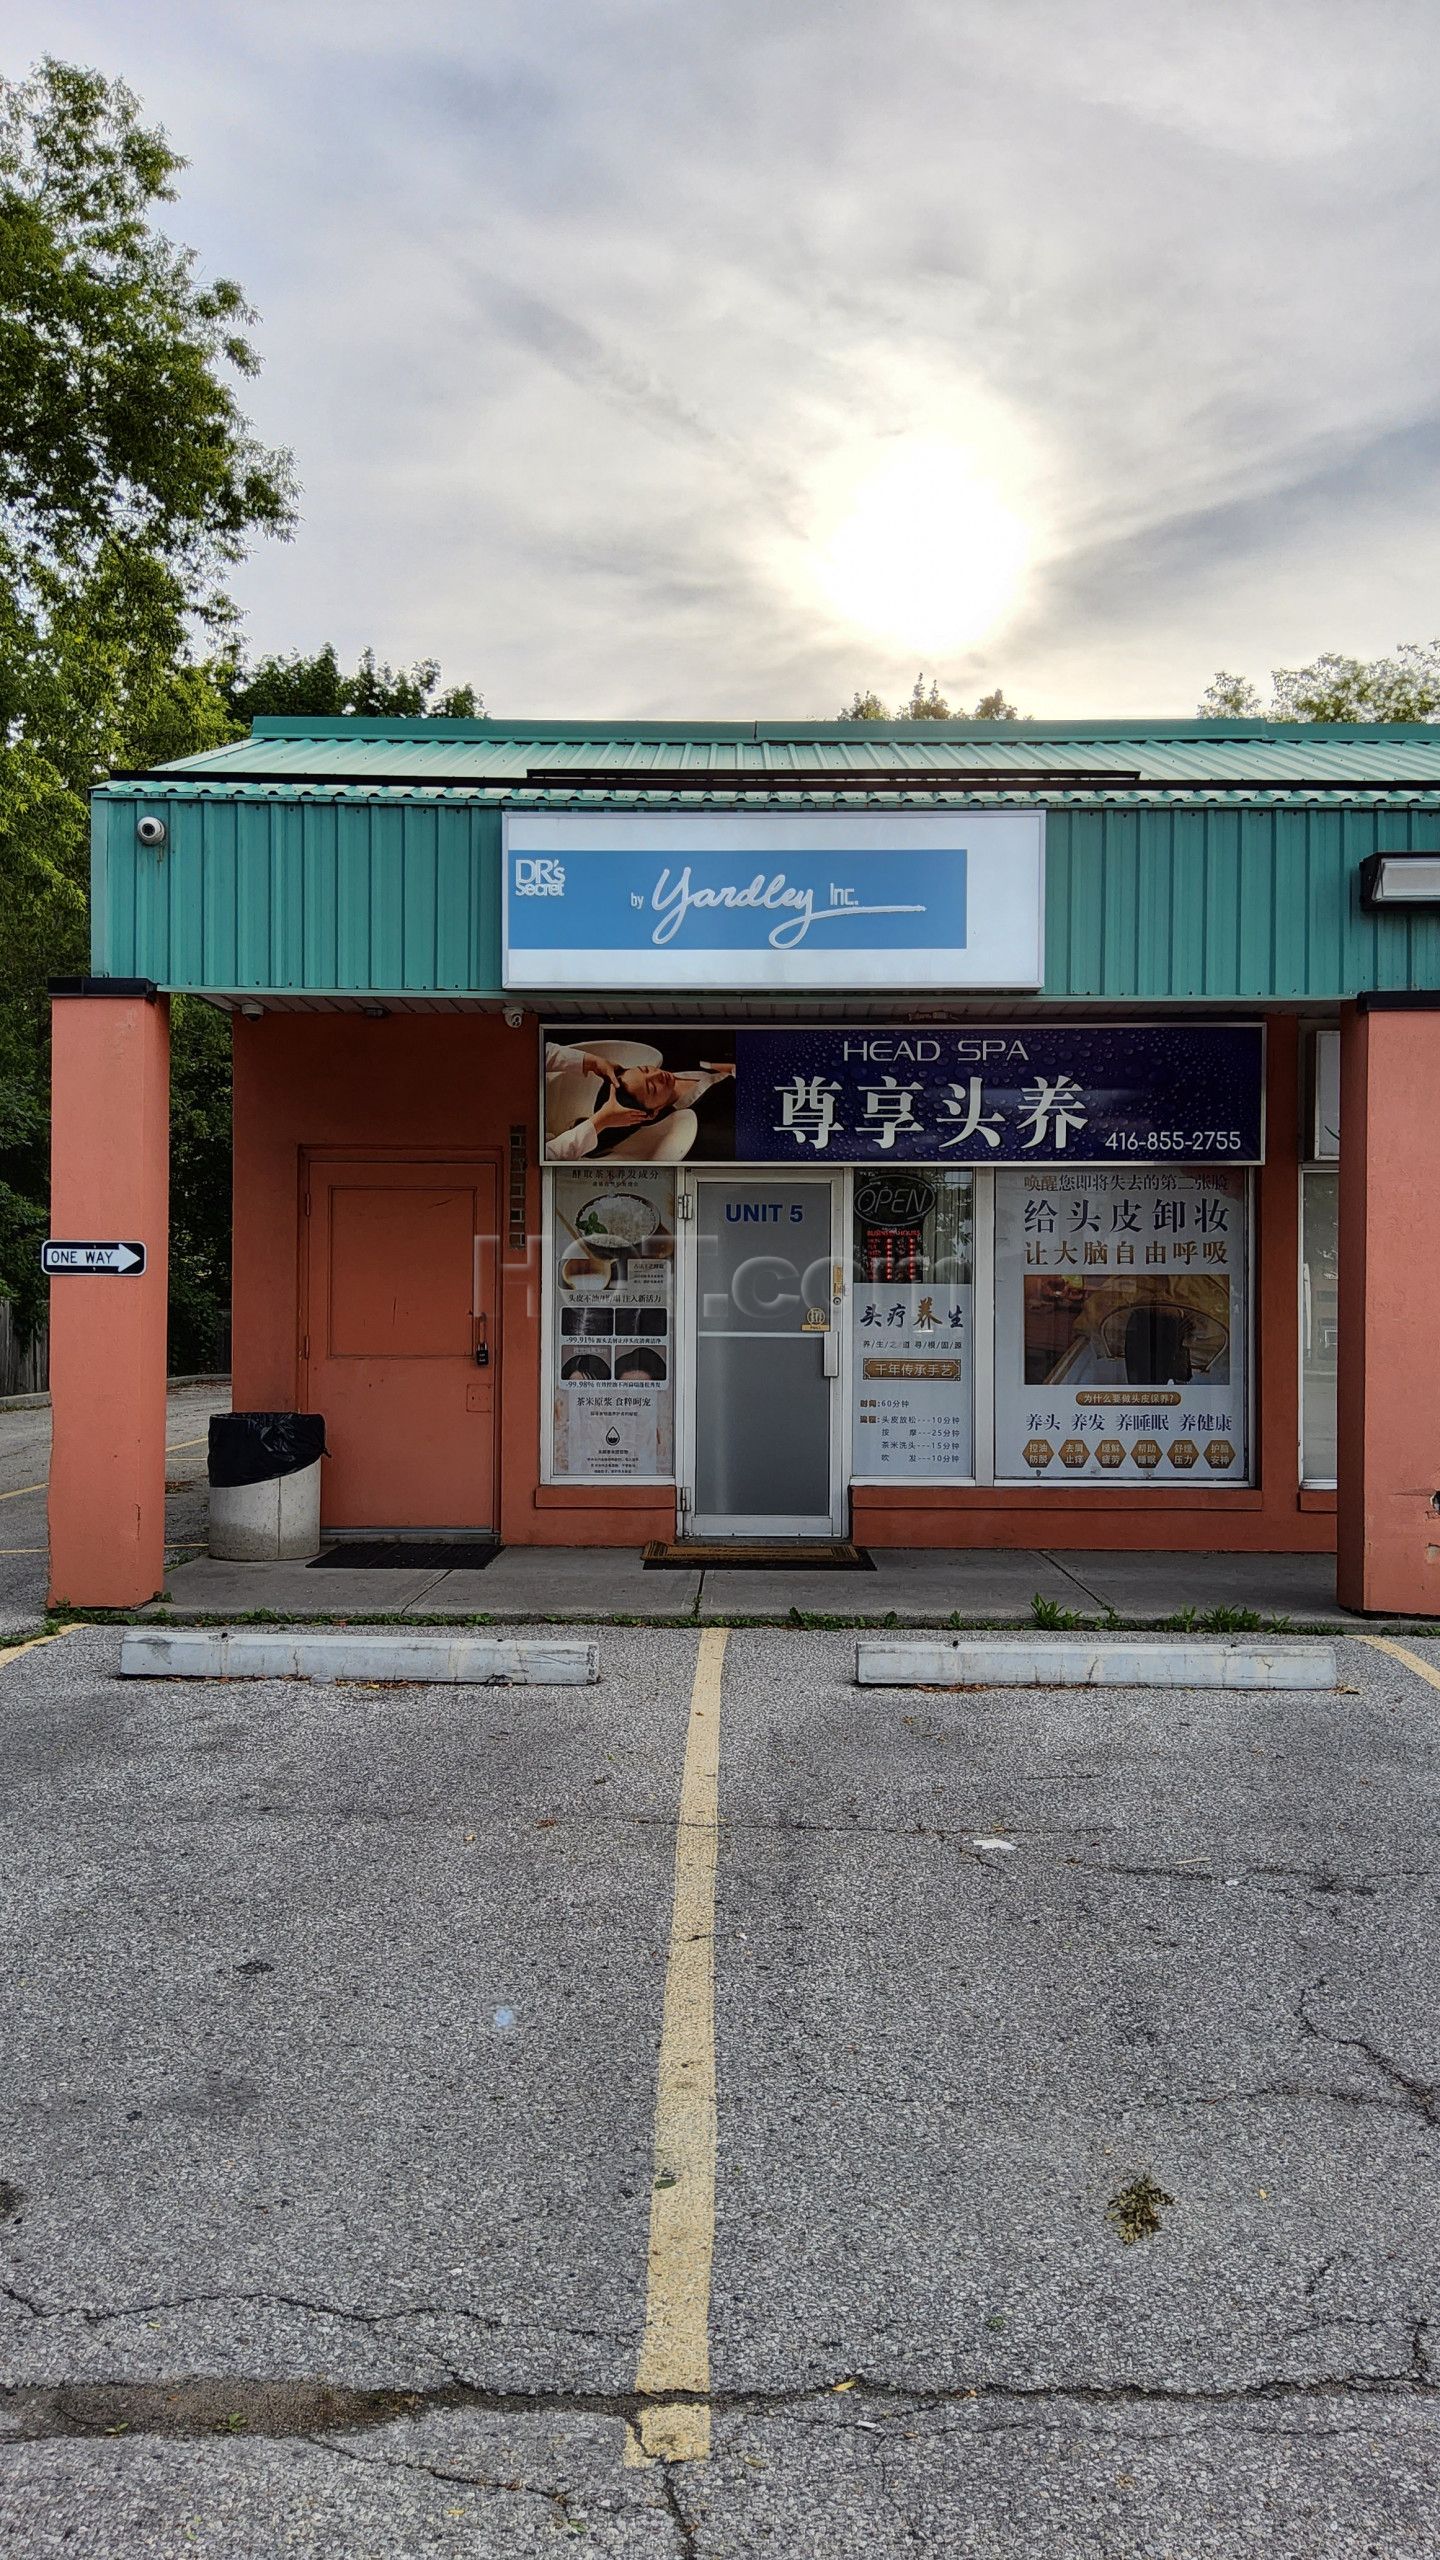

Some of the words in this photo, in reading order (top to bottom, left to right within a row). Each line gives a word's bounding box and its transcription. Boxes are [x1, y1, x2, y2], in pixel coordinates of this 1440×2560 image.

[515, 859, 566, 884] DR's
[515, 882, 565, 896] Secret
[630, 892, 644, 909] by
[651, 867, 926, 949] Yardley
[829, 883, 859, 906] Inc.
[843, 1040, 941, 1061] HEAD
[957, 1040, 1029, 1061] SPA
[772, 1075, 1089, 1150] 尊享头养
[1105, 1131, 1241, 1151] 416-855-2755
[1024, 1174, 1229, 1191] 唤醒您即将失去的第二张脸
[858, 1189, 927, 1213] OPEN
[726, 1204, 783, 1222] UNIT
[789, 1205, 803, 1222] 5
[1024, 1198, 1230, 1233] 给头皮卸妆
[51, 1251, 77, 1263] ONE
[86, 1251, 113, 1264] WAY
[1024, 1240, 1229, 1266] 让大脑自由呼吸
[860, 1297, 964, 1329] 头疗养生
[875, 1363, 953, 1376] 千年传承手艺
[1084, 1393, 1175, 1404] 为什么要做头皮保养?
[1025, 1413, 1061, 1432] 养头
[1071, 1413, 1106, 1432] 养发
[1116, 1413, 1169, 1432] 养睡眠
[1179, 1413, 1232, 1432] 养健康
[1137, 1443, 1156, 1454] 帮助
[1029, 1454, 1048, 1465] 防脱
[1065, 1454, 1084, 1465] 止痒
[1101, 1454, 1120, 1465] 疲劳
[1174, 1454, 1193, 1465] 压力
[1210, 1454, 1229, 1465] 安神
